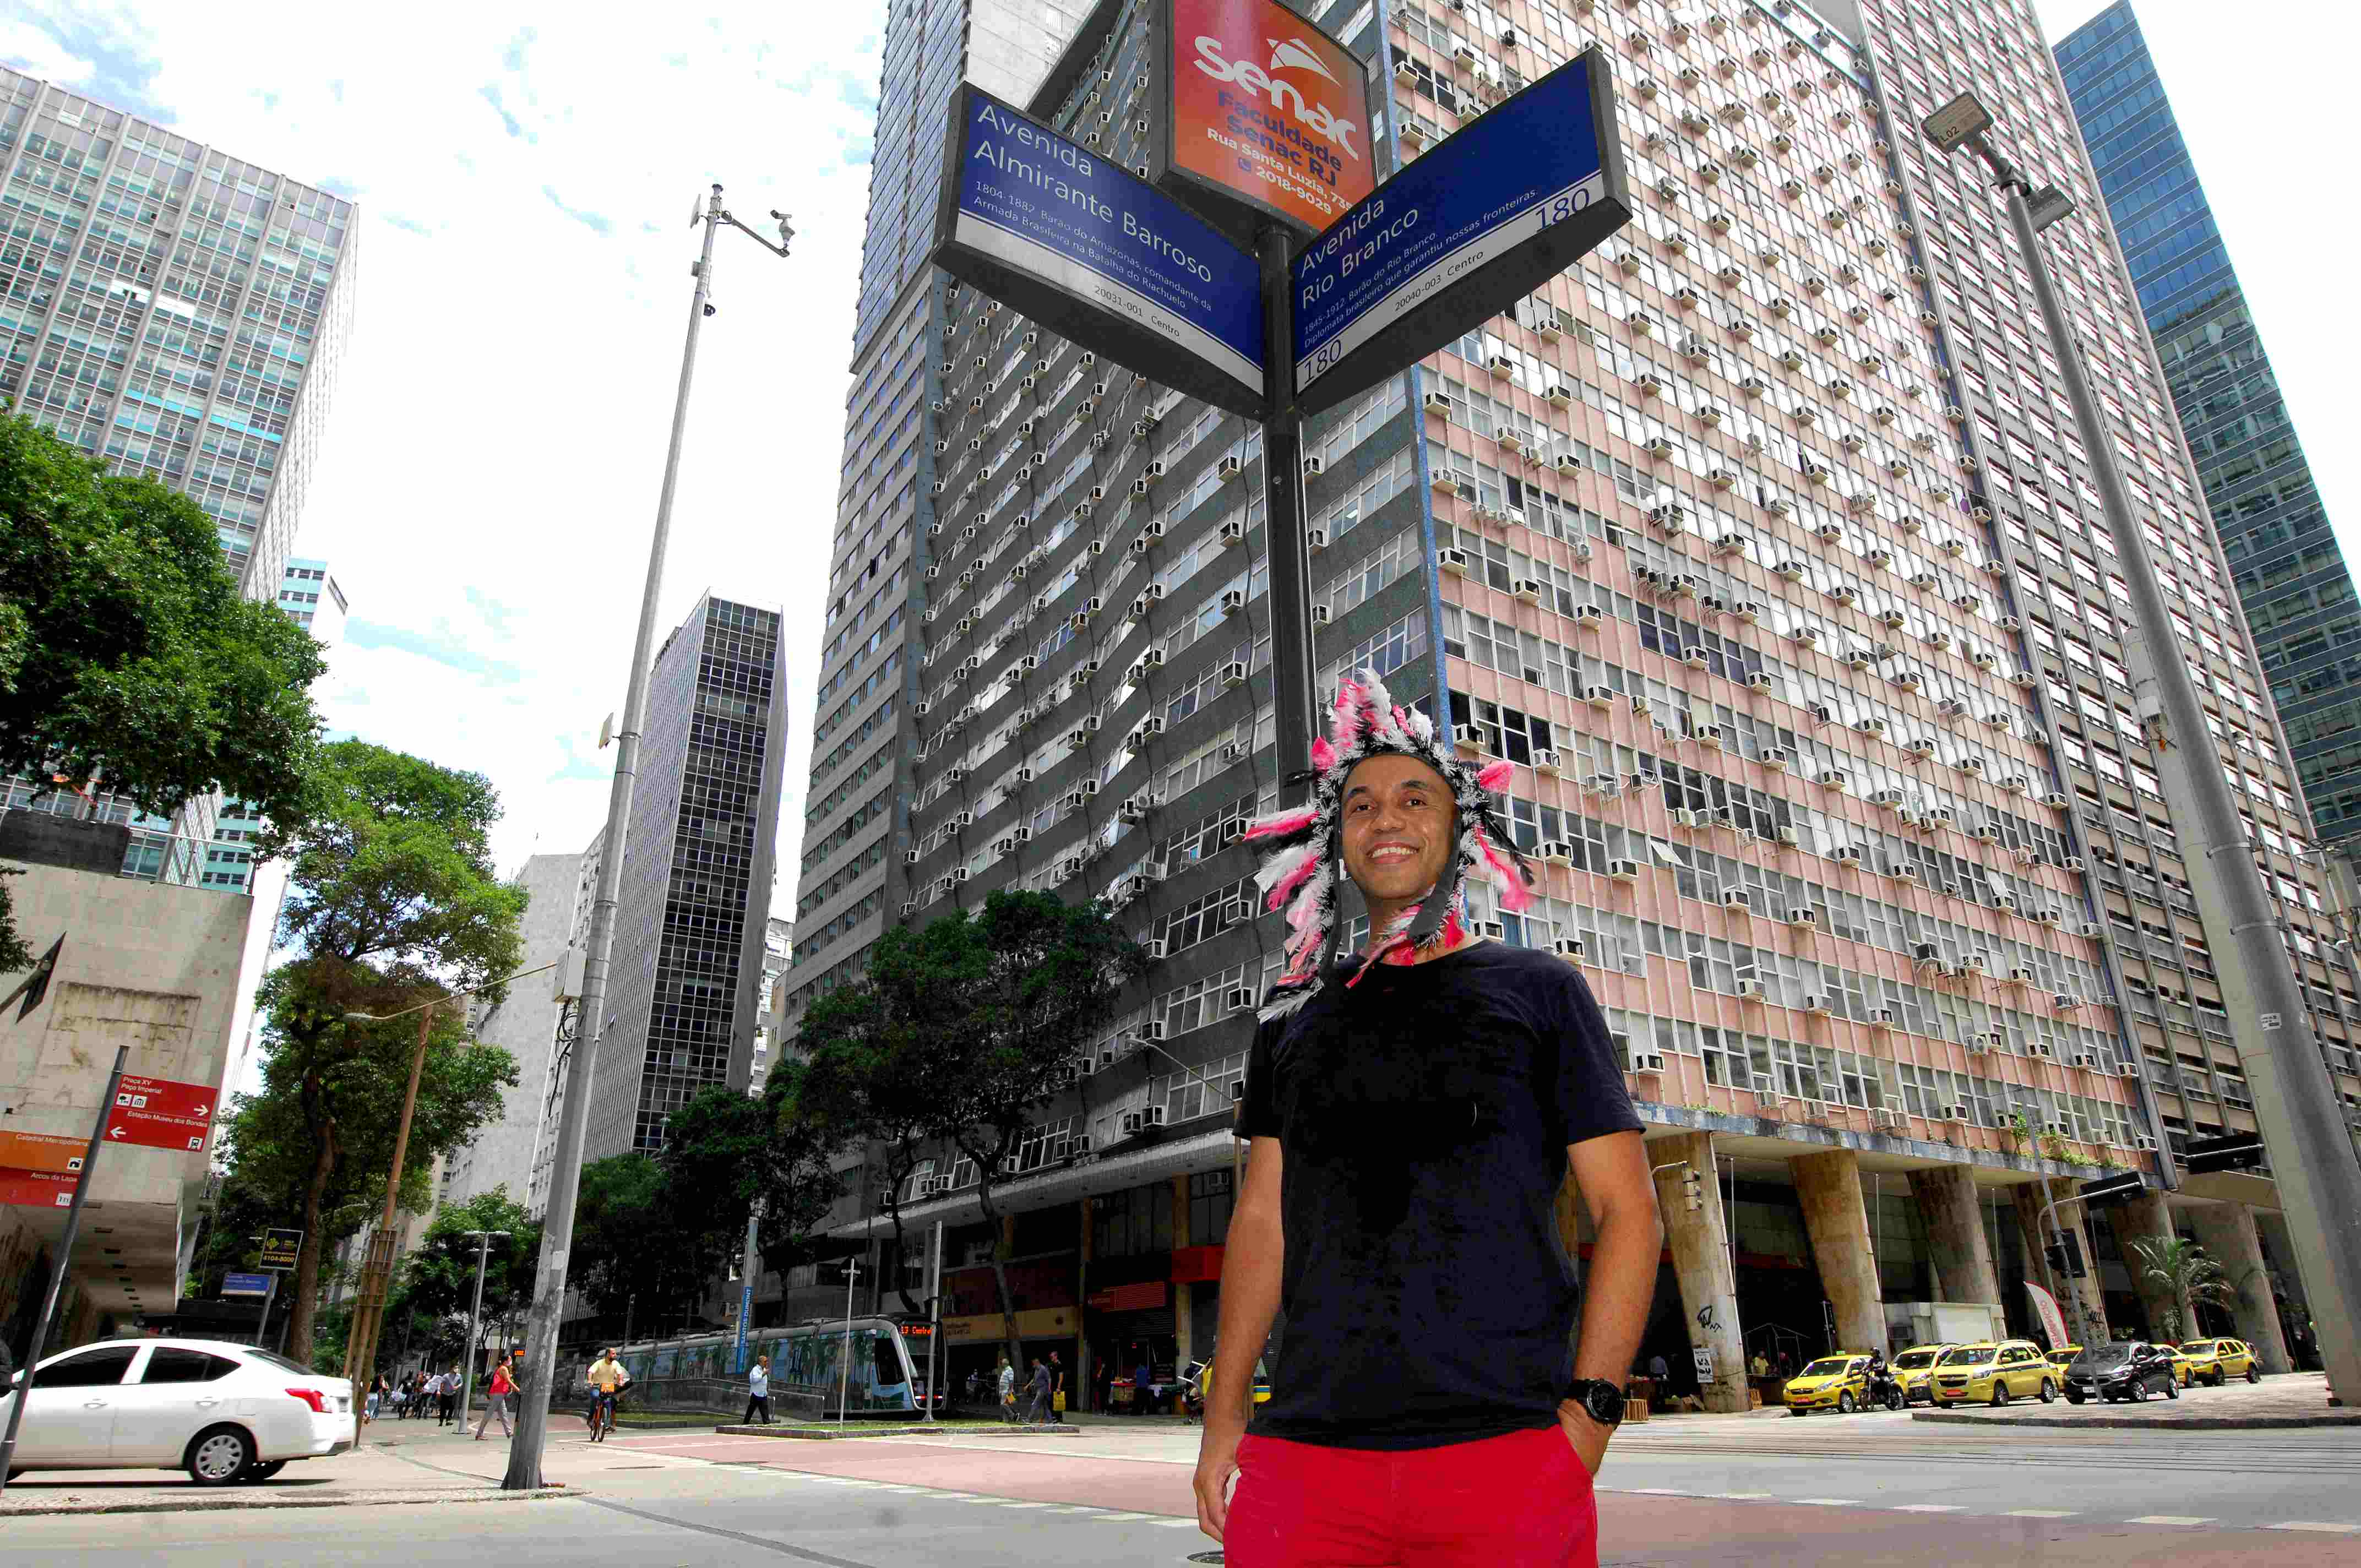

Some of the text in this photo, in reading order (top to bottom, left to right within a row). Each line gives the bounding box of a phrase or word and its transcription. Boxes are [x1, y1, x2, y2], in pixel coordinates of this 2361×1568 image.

[978, 105, 1092, 176] Avenida
[1207, 127, 1238, 150] Rua
[1242, 143, 1285, 172] Santa
[1288, 166, 1328, 199] Luzia,
[1217, 90, 1342, 171] Faculdade
[1227, 115, 1336, 186] Senac RJ
[974, 140, 1211, 282] Almirante Barroso
[1256, 166, 1331, 214] 2018-9029
[1535, 188, 1590, 233] 180
[974, 196, 1018, 221] Armada
[1022, 216, 1069, 246] Brasileira
[1073, 242, 1085, 253] na
[1089, 248, 1124, 273] Batalha
[1127, 269, 1139, 282] do
[1074, 227, 1087, 239] do
[1145, 265, 1199, 303] comandante
[1201, 299, 1211, 312] da
[1301, 199, 1384, 278] Avenida
[1303, 209, 1418, 309] Rio Branco
[1095, 286, 1179, 337] 20031-001 Centro
[1304, 314, 1344, 349] Diplomata
[1346, 284, 1383, 317] brasileiro
[1385, 270, 1401, 286] que
[1404, 242, 1443, 274] garantiu
[1445, 220, 1480, 244] nossas
[1349, 279, 1372, 300] Barão
[1374, 267, 1385, 280] do
[1387, 255, 1401, 270] Rio
[1395, 251, 1484, 312] 20040-003 Centro
[1304, 339, 1341, 384] 180
